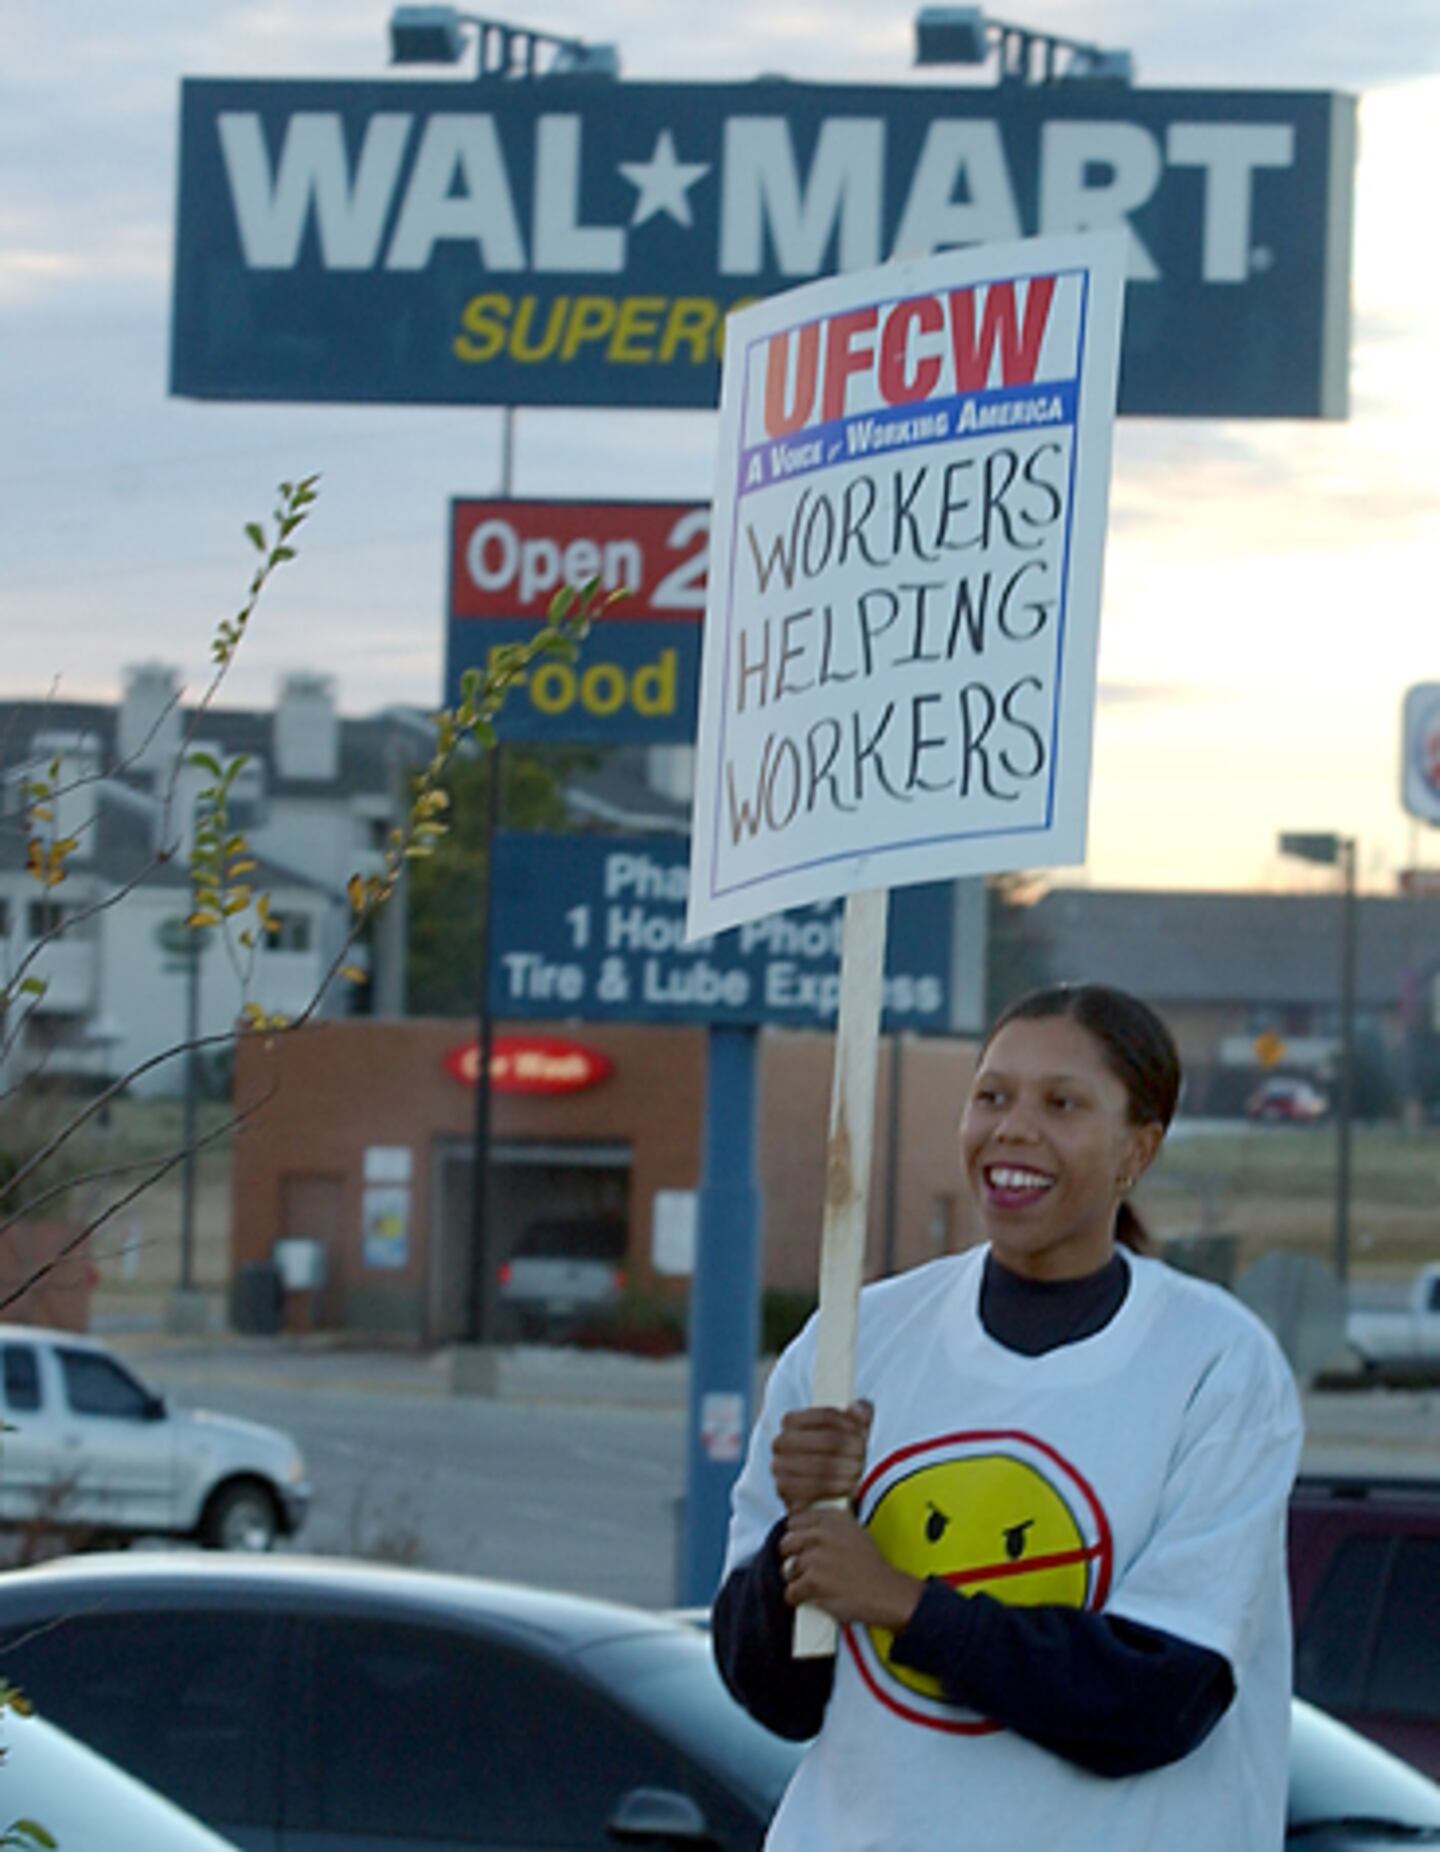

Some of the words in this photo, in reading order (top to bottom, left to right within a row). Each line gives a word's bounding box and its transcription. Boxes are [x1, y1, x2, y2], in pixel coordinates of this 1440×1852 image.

[454, 292, 762, 364] SUPER
[764, 275, 1058, 438] UFCW
[746, 453, 763, 486] A
[466, 517, 643, 606] Open
[747, 443, 1063, 594] WORKERS
[737, 560, 1058, 714] HELPING
[727, 675, 1046, 847] WORKERS
[566, 905, 589, 949] 1
[503, 953, 586, 999] Tire
[598, 955, 631, 1002] &
[643, 959, 750, 1007] Lube
[765, 961, 943, 1018] Expss
